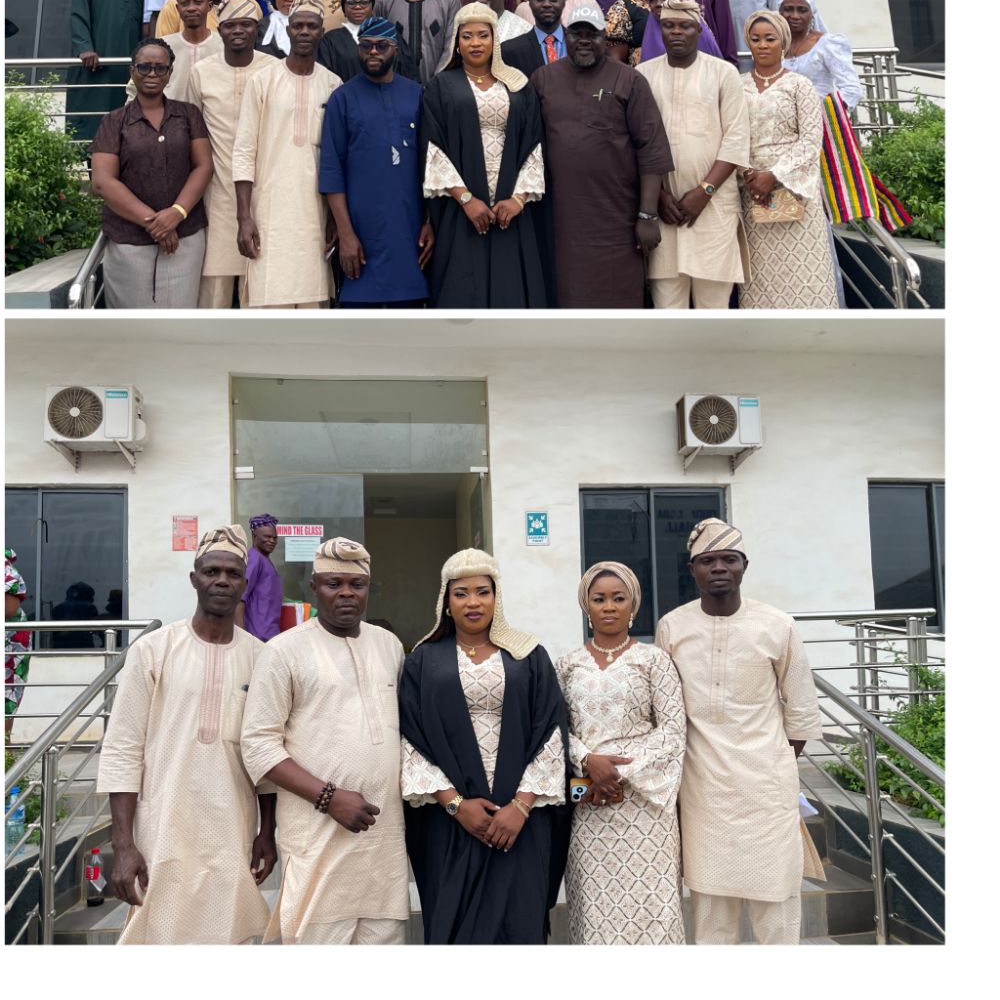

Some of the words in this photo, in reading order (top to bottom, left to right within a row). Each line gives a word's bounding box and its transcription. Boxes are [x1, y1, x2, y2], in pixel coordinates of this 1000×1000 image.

[572, 7, 599, 20] HOA
[293, 525, 303, 535] THE
[304, 526, 322, 536] GLASS
